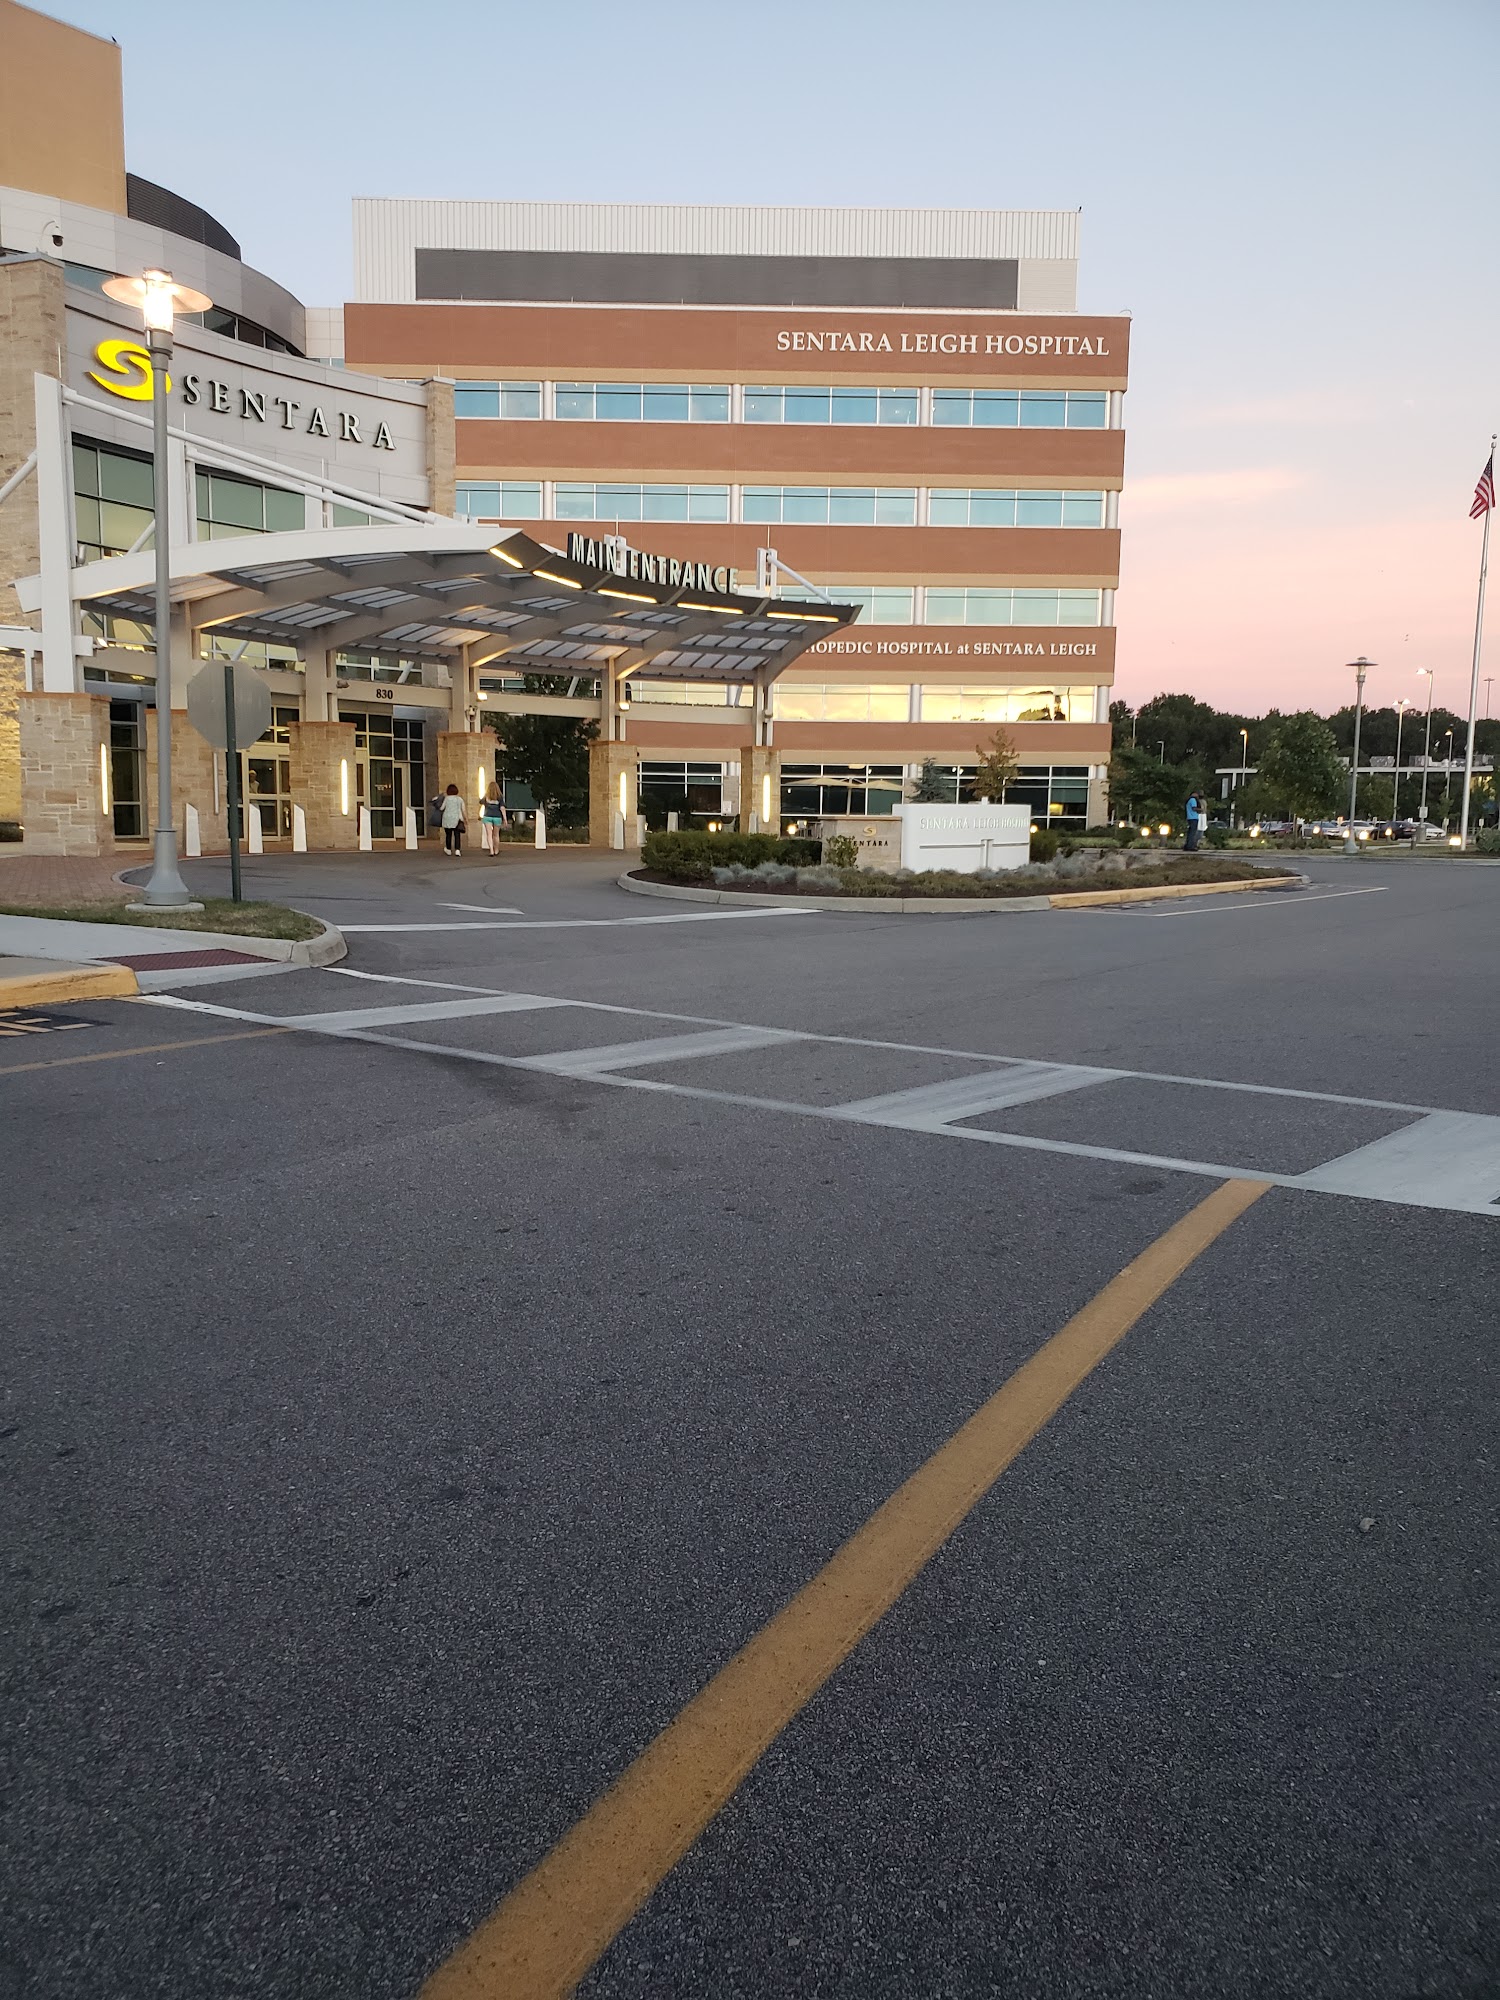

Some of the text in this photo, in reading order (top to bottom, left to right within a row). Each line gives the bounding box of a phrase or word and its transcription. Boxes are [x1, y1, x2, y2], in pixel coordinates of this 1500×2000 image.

[776, 331, 1109, 356] SENTARA LEIGH HOSPITAL
[183, 374, 396, 450] SENTARA
[568, 532, 739, 594] MAIN ENTRANCE
[877, 642, 952, 654] HOSPITAL
[957, 644, 970, 654] at
[973, 642, 1046, 655] SENTARA
[1050, 643, 1097, 656] LEIGH
[376, 688, 393, 699] 830
[919, 817, 970, 830] SENTARA
